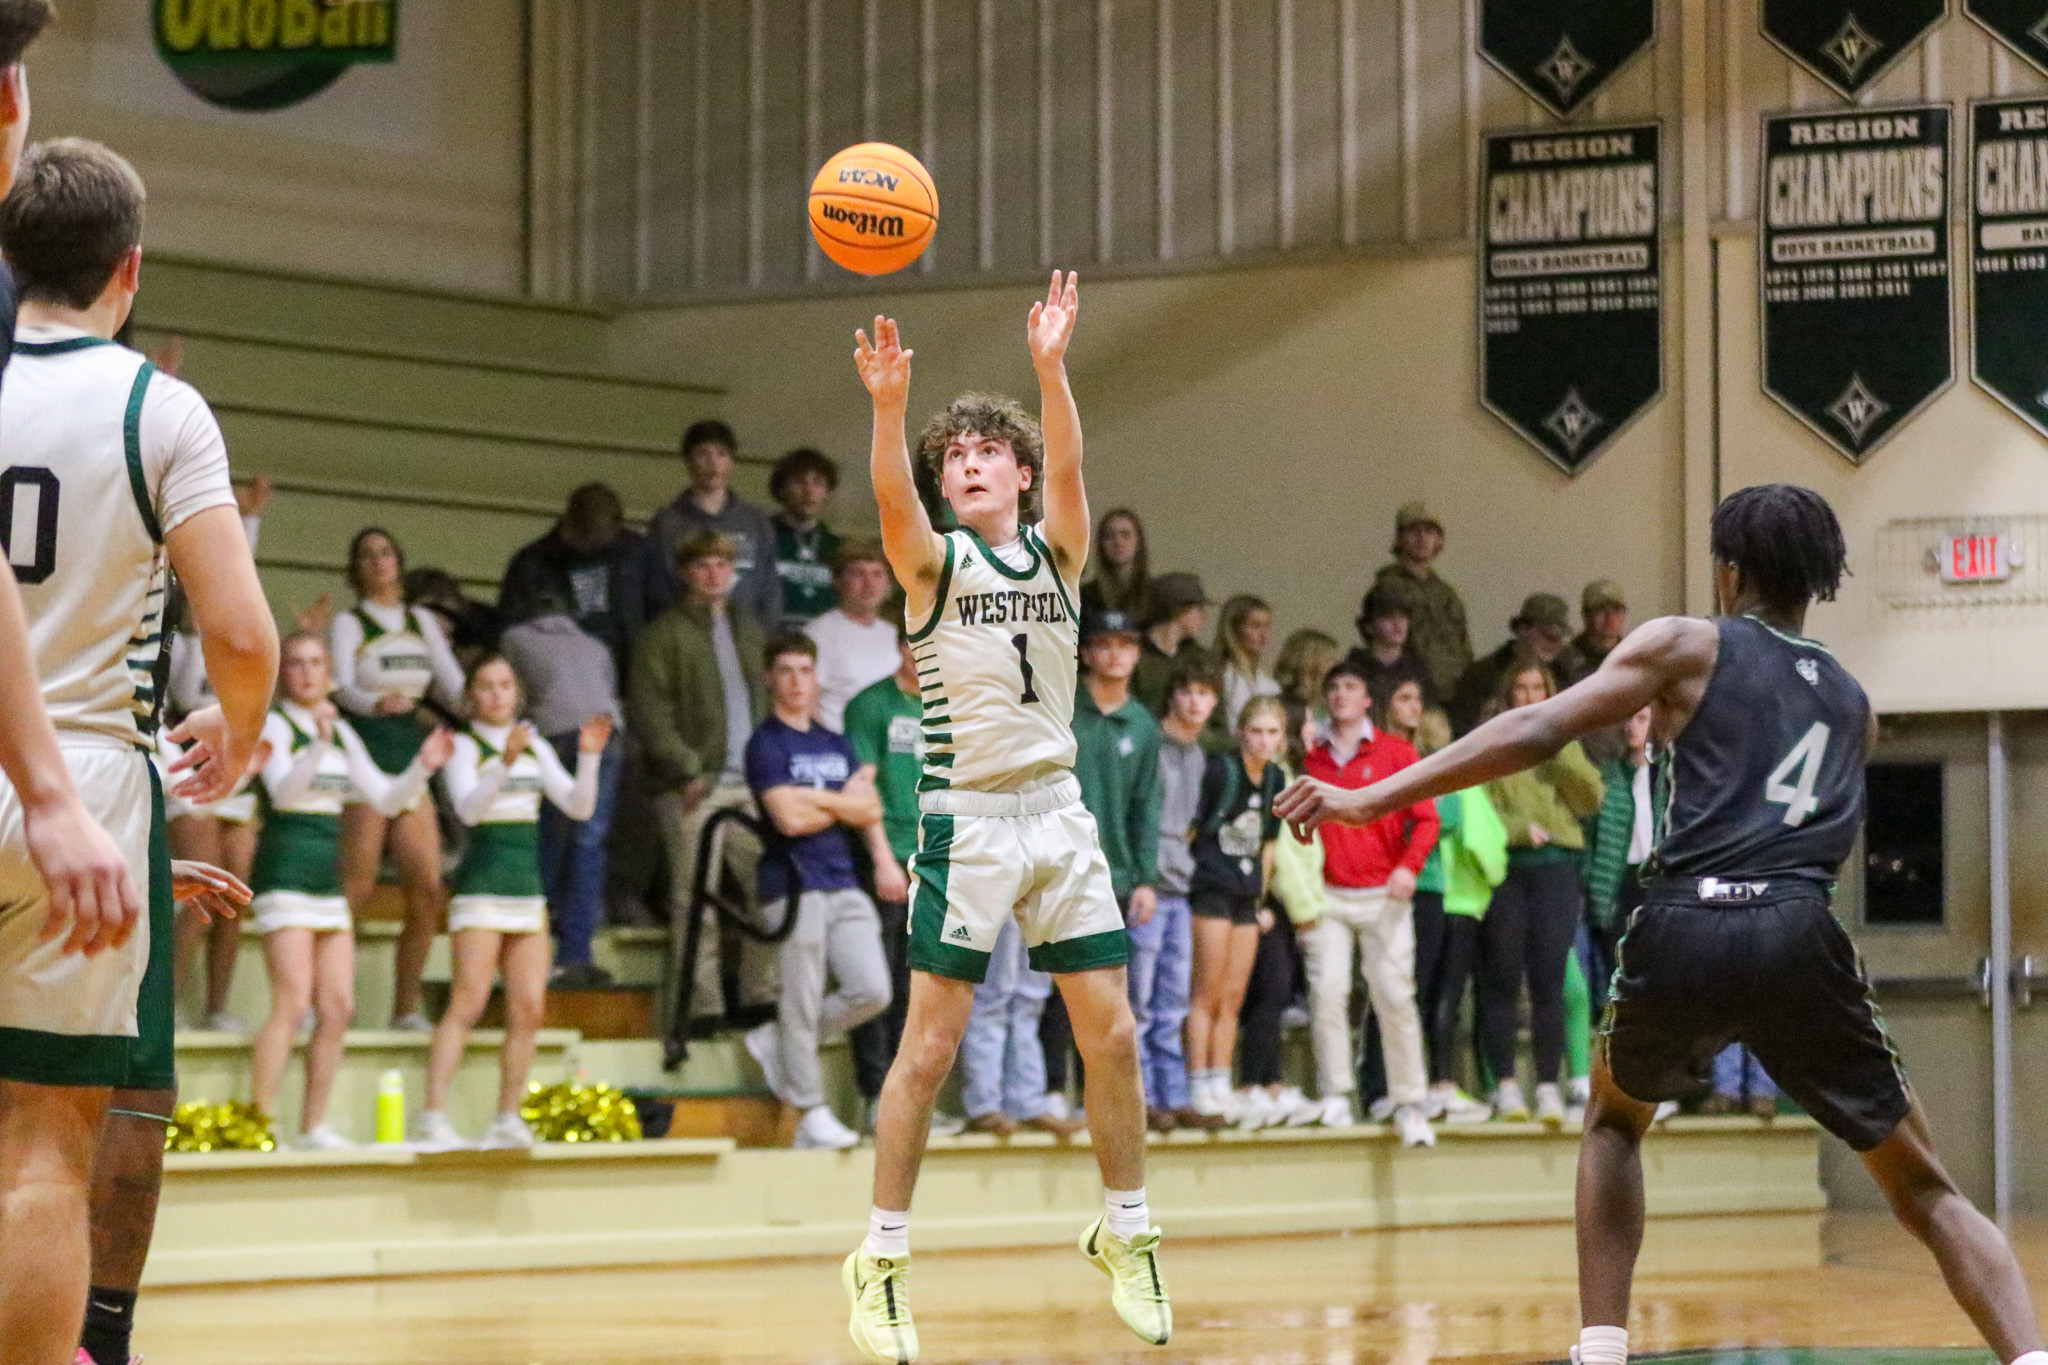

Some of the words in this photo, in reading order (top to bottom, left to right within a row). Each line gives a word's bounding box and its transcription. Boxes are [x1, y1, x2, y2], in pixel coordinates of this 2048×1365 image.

[1789, 116, 1920, 145] REGION
[1510, 134, 1634, 163] REGION
[838, 168, 900, 192] NCAA
[1768, 146, 1943, 230] CHAMPIONS
[822, 202, 905, 237] Wilson
[1489, 164, 1655, 244] CHAMPIONS
[1542, 250, 1645, 269] BASKETBALL
[1777, 241, 1817, 257] BOYS
[1822, 235, 1930, 255] BASKETBALL
[1953, 536, 1998, 578] EXIT
[1011, 633, 1040, 704] 1
[1765, 721, 1830, 827] 4
